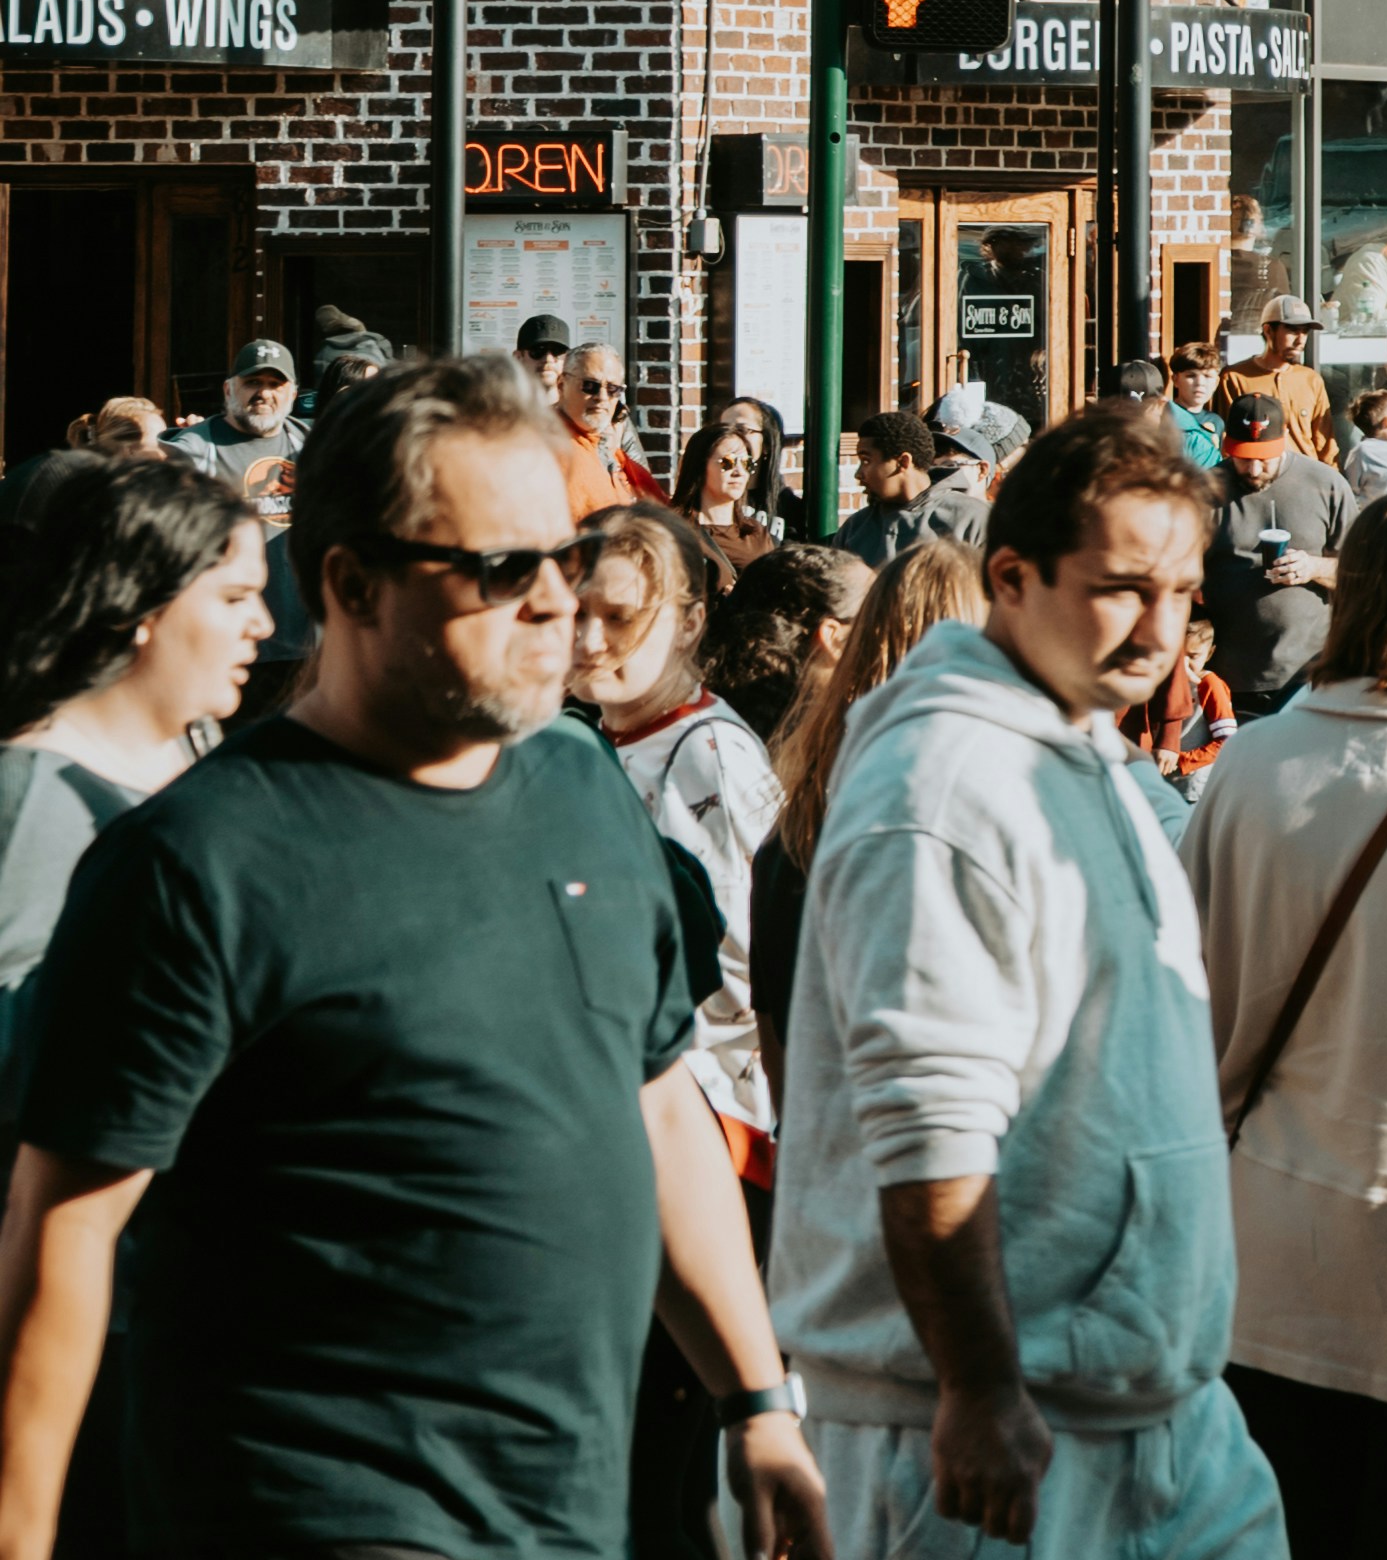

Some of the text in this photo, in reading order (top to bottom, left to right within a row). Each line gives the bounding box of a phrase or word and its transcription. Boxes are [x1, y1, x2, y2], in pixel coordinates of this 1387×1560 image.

[1170, 21, 1255, 77] PASTA
[1268, 25, 1310, 80] SALA
[965, 304, 1032, 331] SMITH & SON
